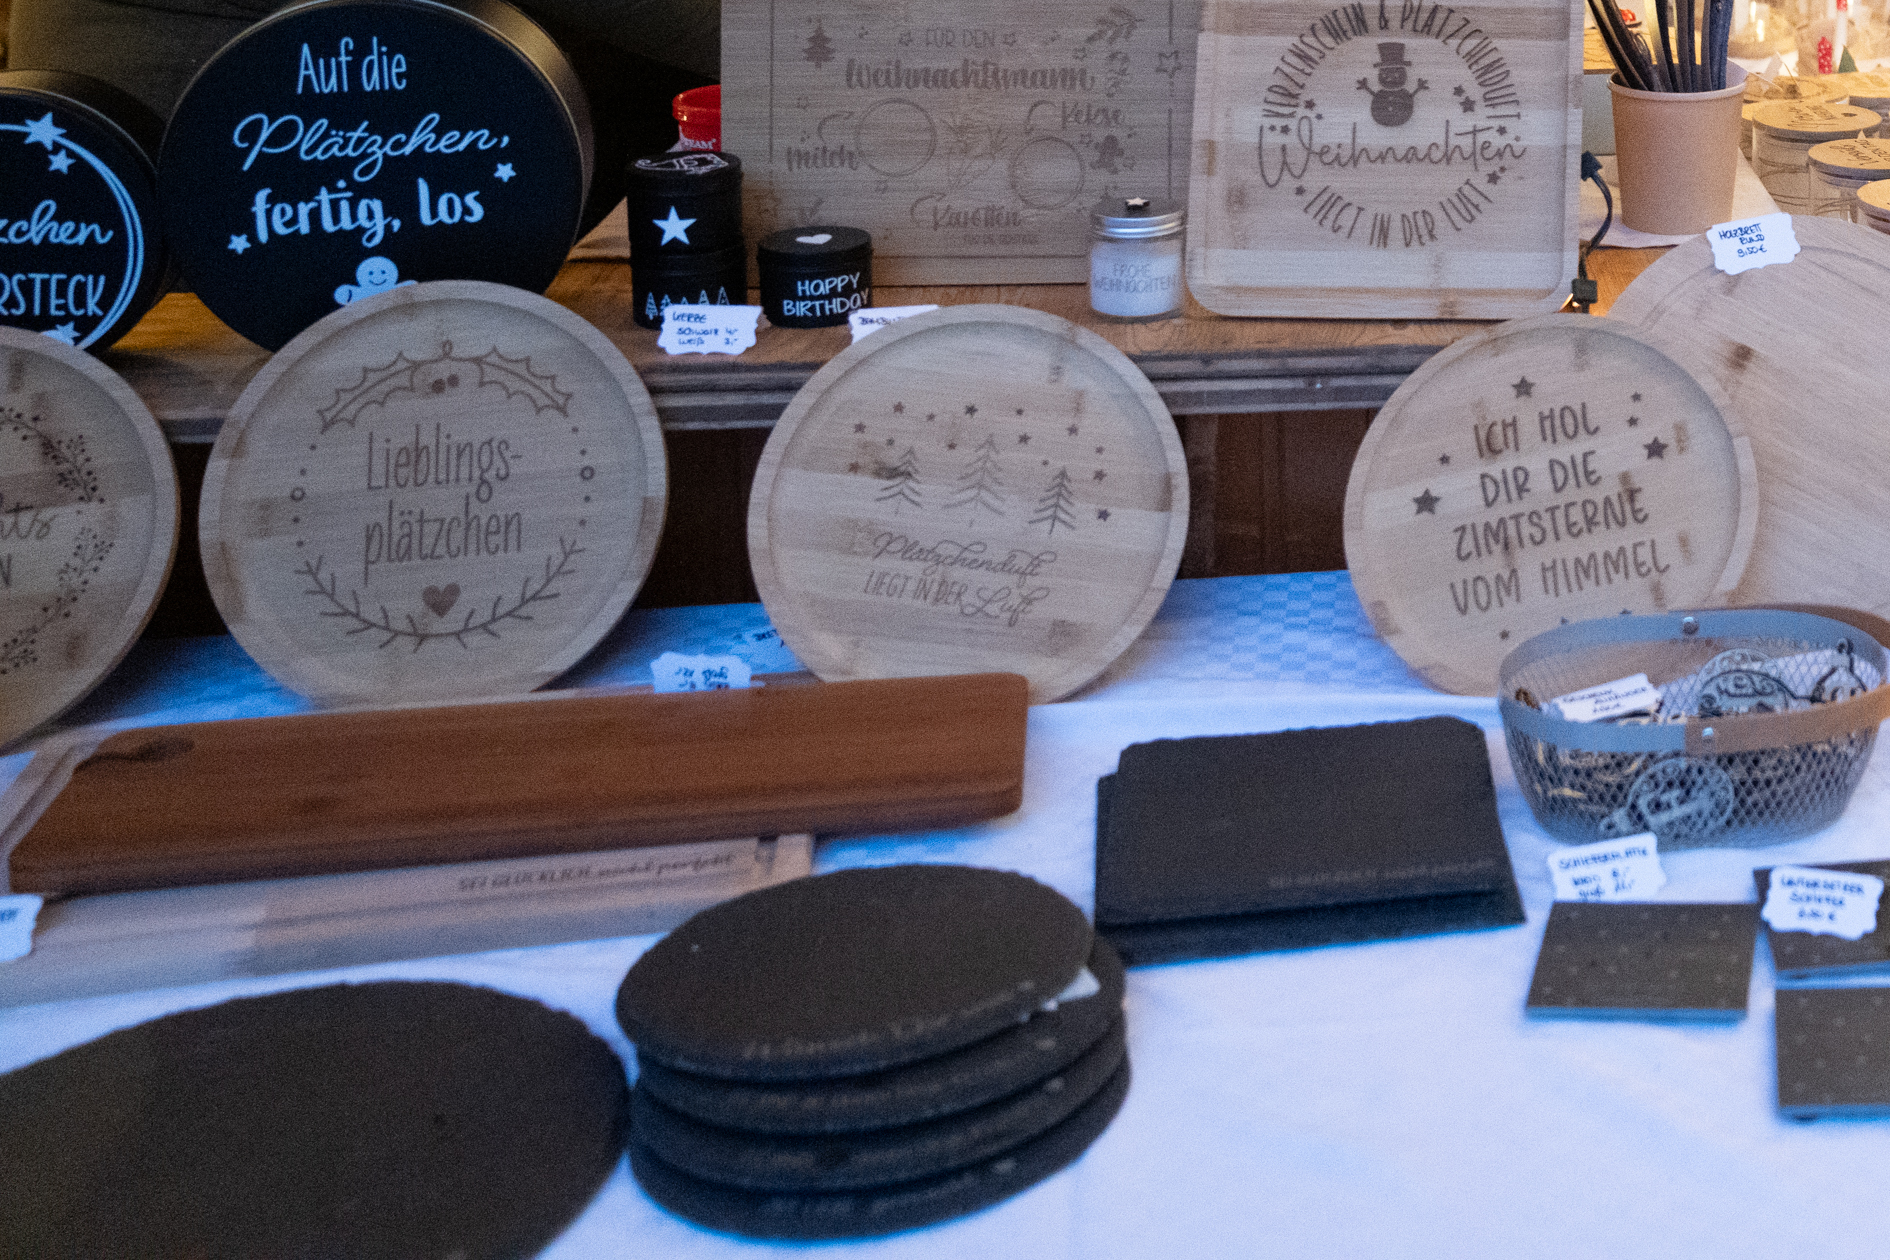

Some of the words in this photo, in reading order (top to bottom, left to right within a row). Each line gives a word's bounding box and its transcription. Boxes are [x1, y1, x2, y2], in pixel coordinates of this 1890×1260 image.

[297, 38, 354, 95] Auf
[362, 37, 408, 92] die
[846, 58, 1095, 91] Weihnachtsmann
[1263, 2, 1368, 120] KERZENSCHEIN
[233, 113, 511, 182] Plätzchen,
[1258, 114, 1527, 189] Weihnachten
[251, 179, 403, 246] fertig,
[417, 178, 485, 226] los
[1303, 185, 1362, 235] LIEGT
[1371, 212, 1392, 248] IN
[1401, 209, 1439, 249] DER
[1439, 177, 1495, 233] LUFT
[364, 420, 523, 503] Lieblings-
[1474, 416, 1521, 460] ICH
[1537, 401, 1601, 444] HOL
[1479, 463, 1532, 509] DIR
[1549, 450, 1602, 495] DIE
[363, 495, 524, 586] plätzchen
[1453, 487, 1649, 562] ZIMTSTERNE
[864, 570, 912, 598] LIEGT
[913, 577, 933, 601] IN
[932, 578, 969, 607] DER
[960, 586, 1051, 627] Luft
[1448, 567, 1522, 616] VOM
[1540, 539, 1671, 598] HIMMEL
